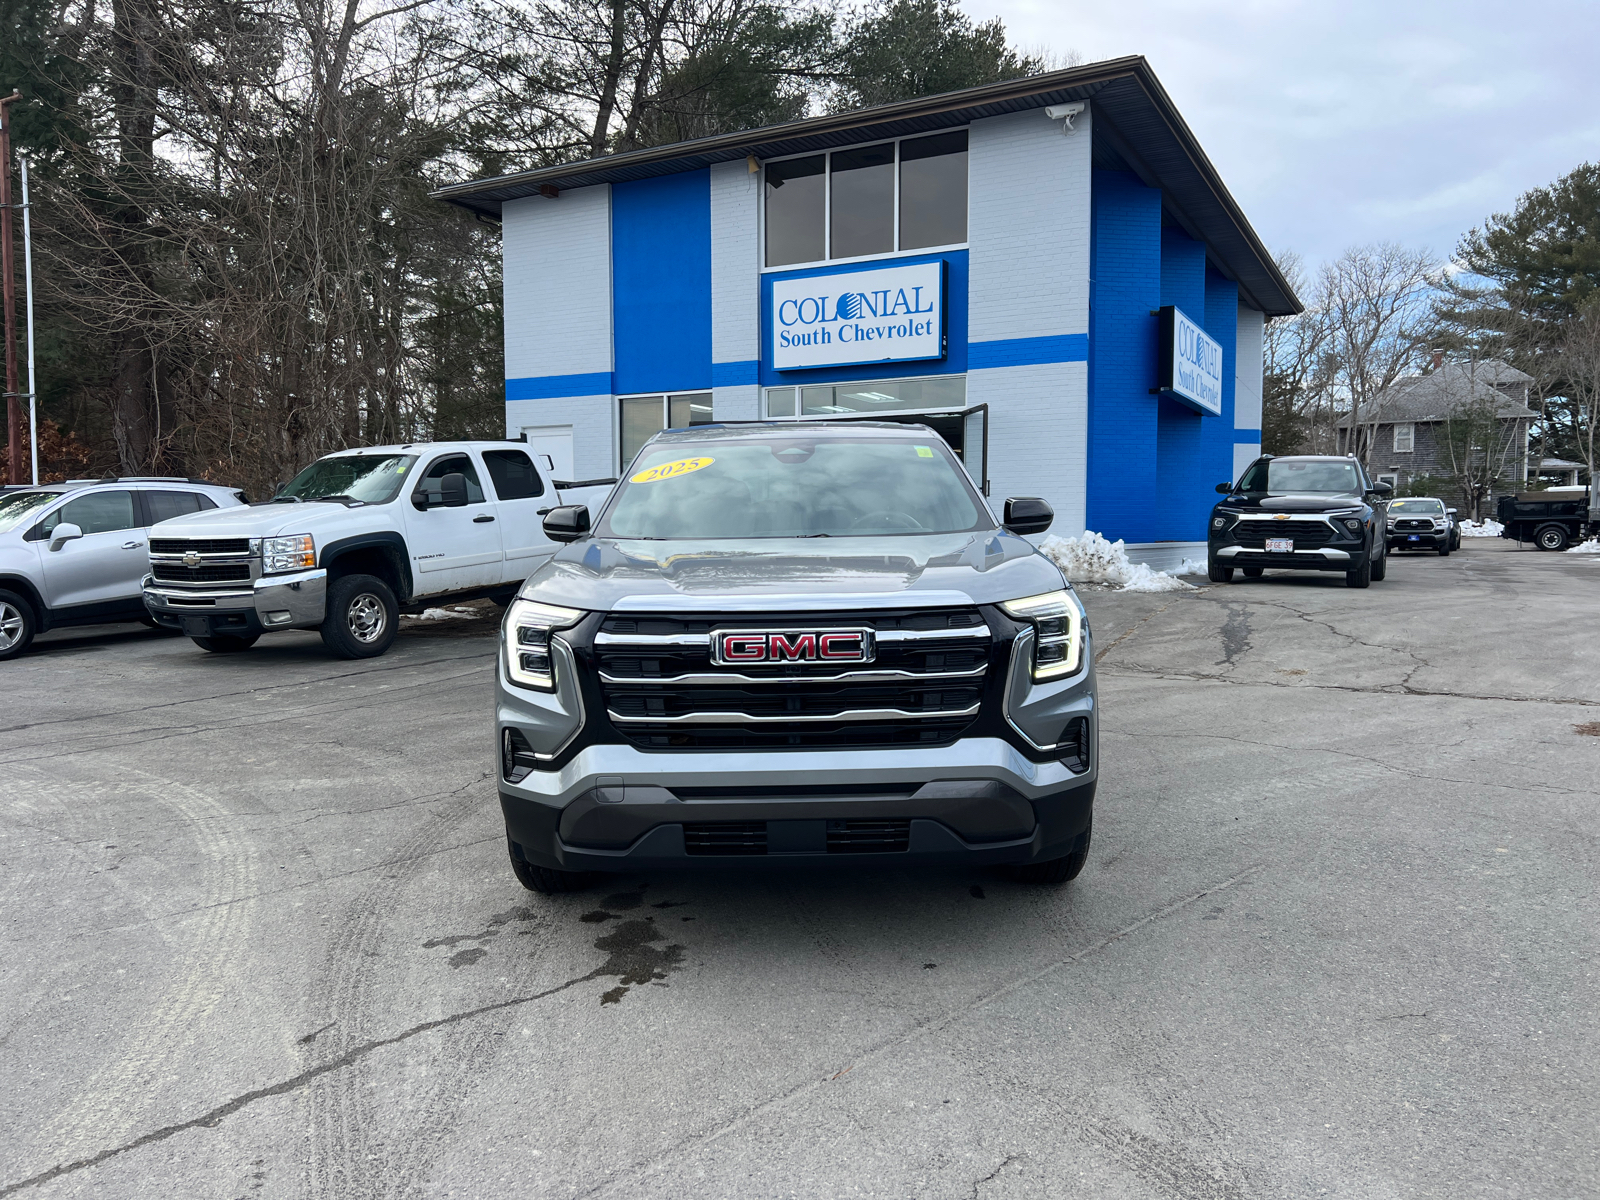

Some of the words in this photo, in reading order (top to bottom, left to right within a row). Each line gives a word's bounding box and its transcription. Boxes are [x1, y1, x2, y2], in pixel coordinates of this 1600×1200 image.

[778, 286, 934, 326] COLONIAL
[780, 327, 832, 348] South
[838, 318, 933, 343] Chevrolet
[1178, 320, 1219, 381] COLONIAL
[1178, 361, 1195, 393] South
[1195, 373, 1219, 407] Chevrolet
[646, 458, 701, 481] 2025
[1284, 541, 1293, 549] 39
[723, 633, 863, 661] GMC
